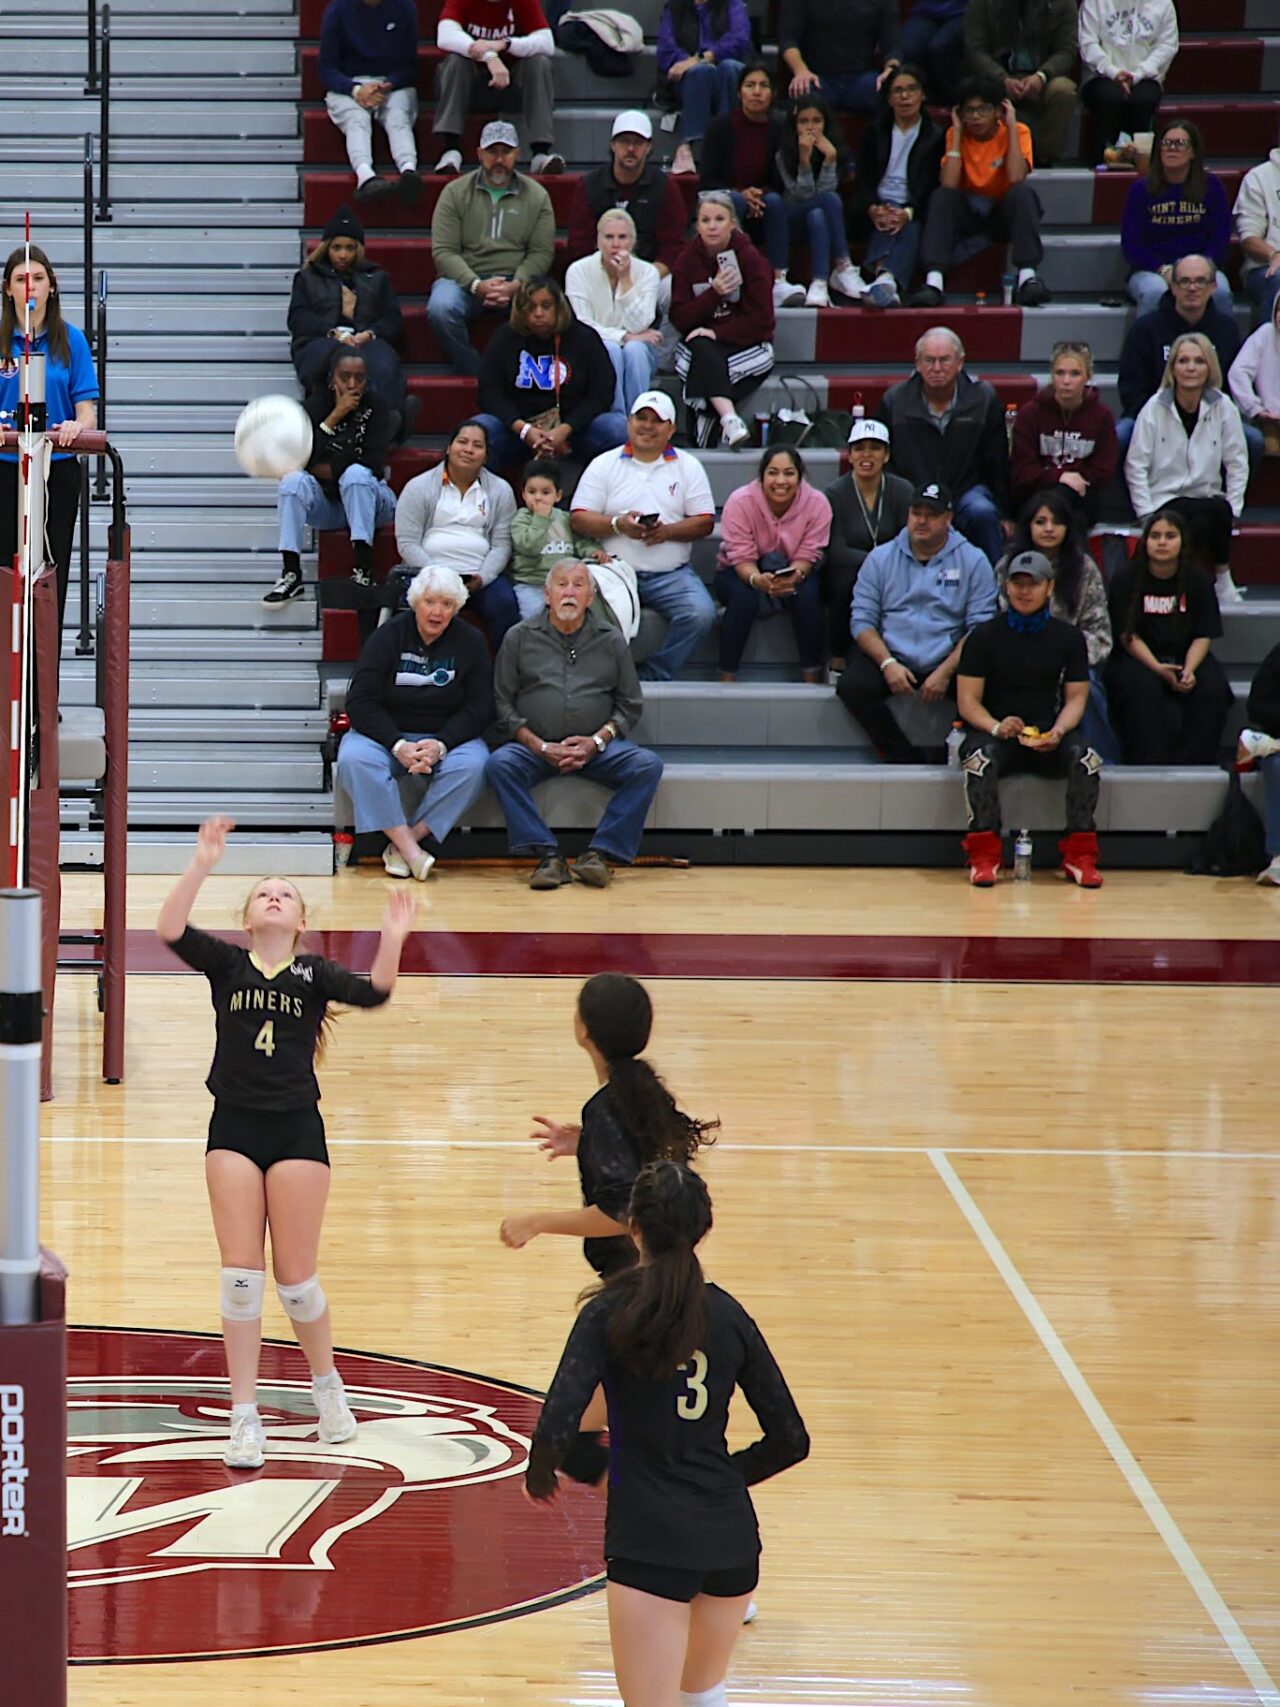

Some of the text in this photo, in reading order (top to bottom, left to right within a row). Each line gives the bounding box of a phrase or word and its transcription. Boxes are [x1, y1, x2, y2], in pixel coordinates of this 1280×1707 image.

[1179, 201, 1206, 214] HILL
[1143, 594, 1186, 614] MARVL
[229, 988, 303, 1018] MINERS
[254, 1020, 276, 1057] 4
[676, 1349, 709, 1421] 3
